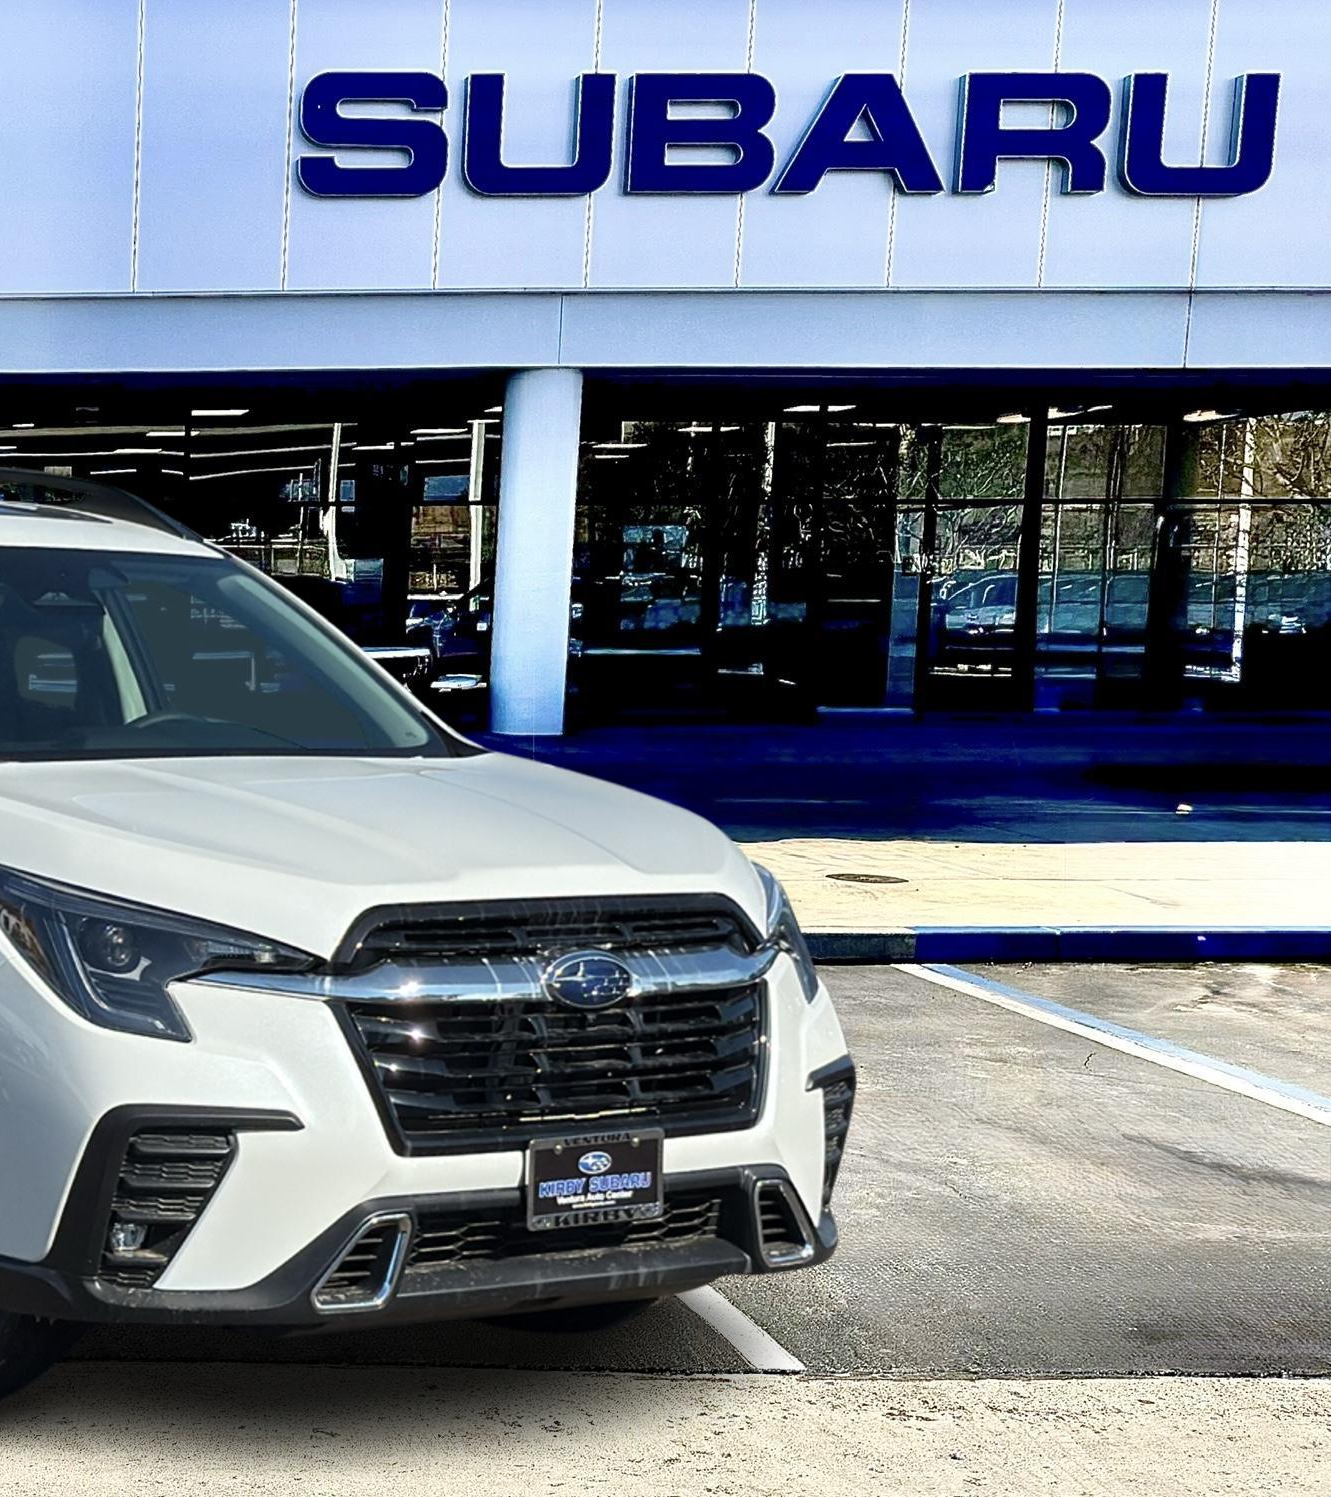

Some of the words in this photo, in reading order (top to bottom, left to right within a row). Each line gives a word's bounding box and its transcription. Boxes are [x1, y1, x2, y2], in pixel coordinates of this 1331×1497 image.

[297, 71, 1279, 197] SUBARU
[564, 1132, 631, 1146] VENTURA
[539, 1178, 586, 1198] KIRBY
[589, 1171, 652, 1193] SUBARU
[554, 1206, 637, 1226] KIRBY
